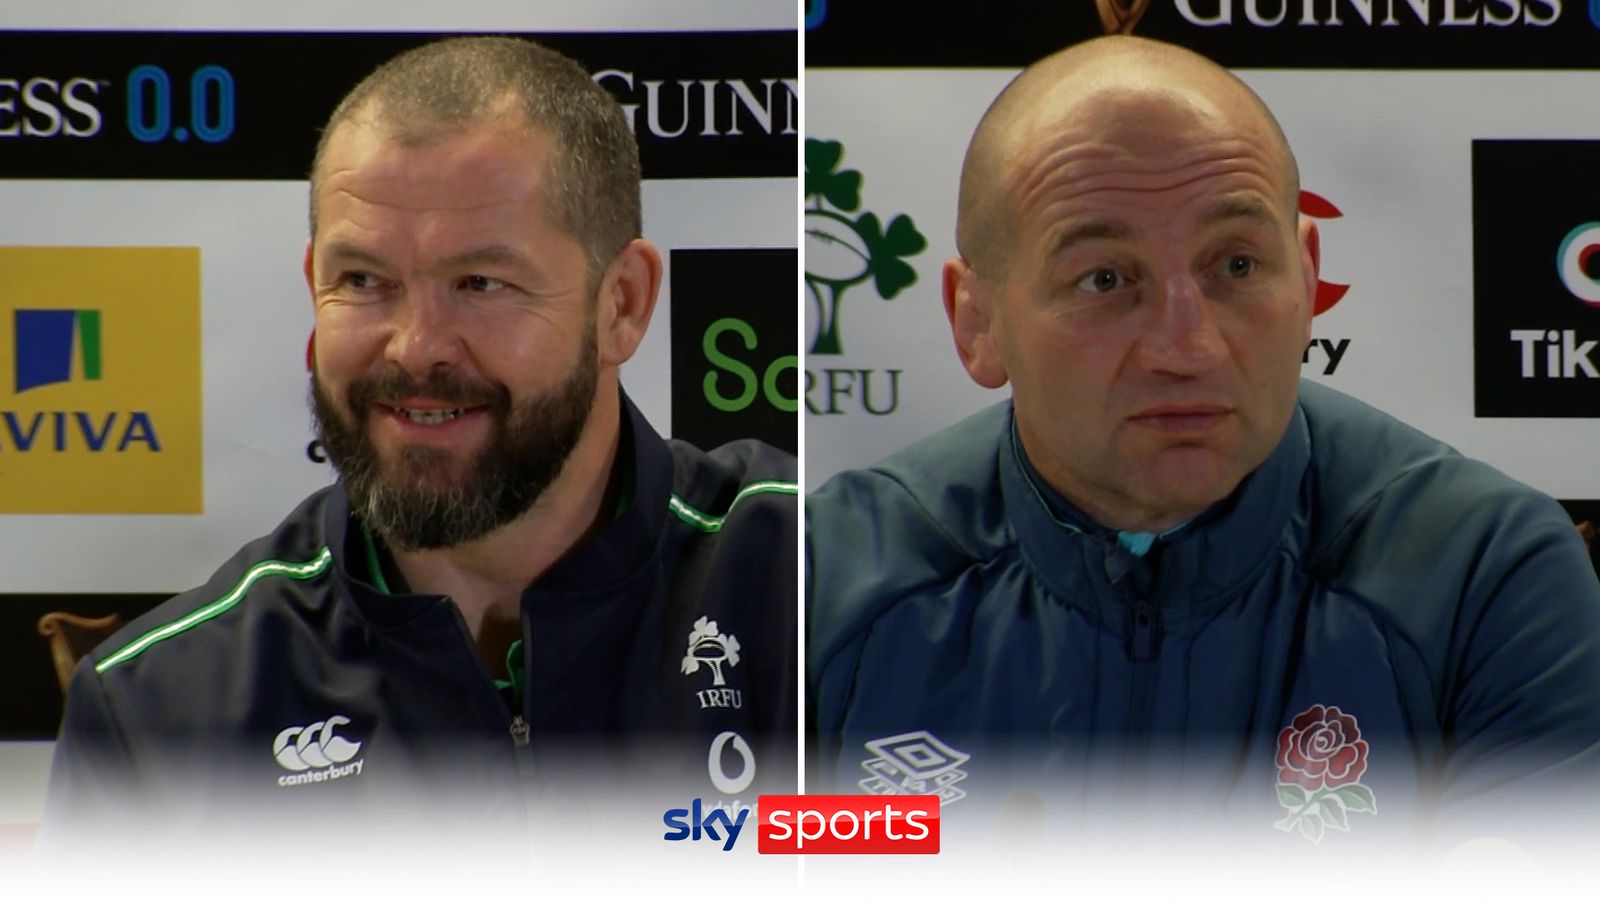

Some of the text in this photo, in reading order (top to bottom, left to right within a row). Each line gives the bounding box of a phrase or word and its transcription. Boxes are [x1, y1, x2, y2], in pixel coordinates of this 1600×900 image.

[126, 64, 235, 142] 0.0
[1510, 329, 1600, 378] Tik
[0, 411, 162, 452] VIVA
[696, 688, 742, 709] IRFU
[278, 758, 364, 787] canterbury
